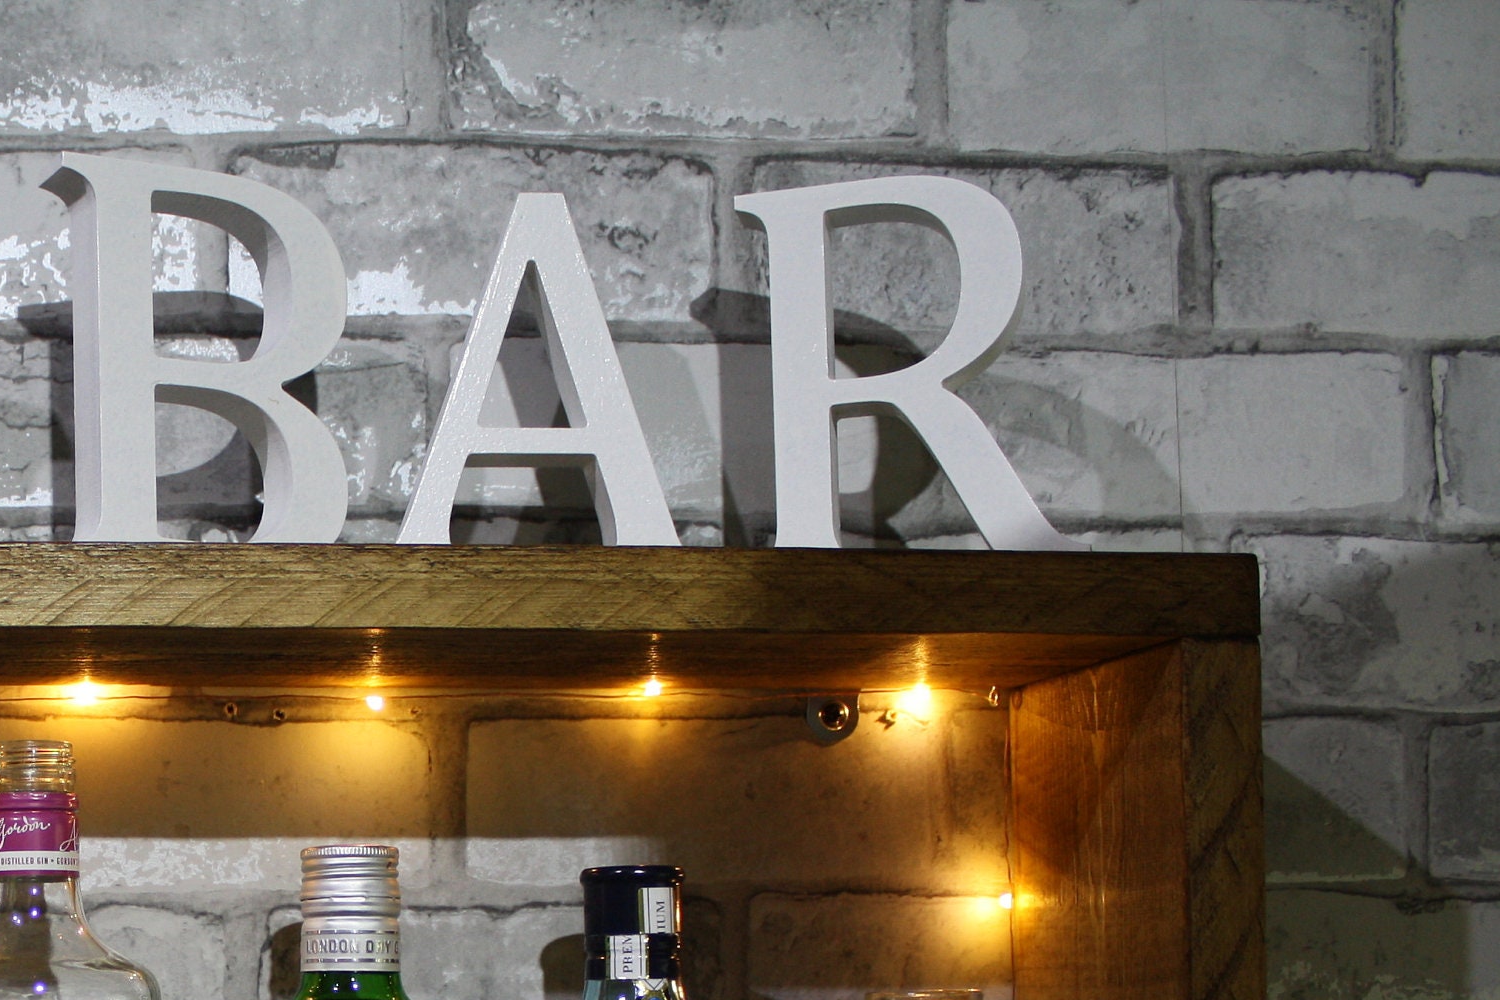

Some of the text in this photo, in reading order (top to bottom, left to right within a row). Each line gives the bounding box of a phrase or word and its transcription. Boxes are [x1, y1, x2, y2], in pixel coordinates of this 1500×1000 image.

[39, 151, 1071, 551] BAR
[1, 856, 34, 866] DISTILLED
[37, 856, 49, 866] GIN
[306, 939, 359, 954] LONDON
[366, 939, 392, 954] DRY
